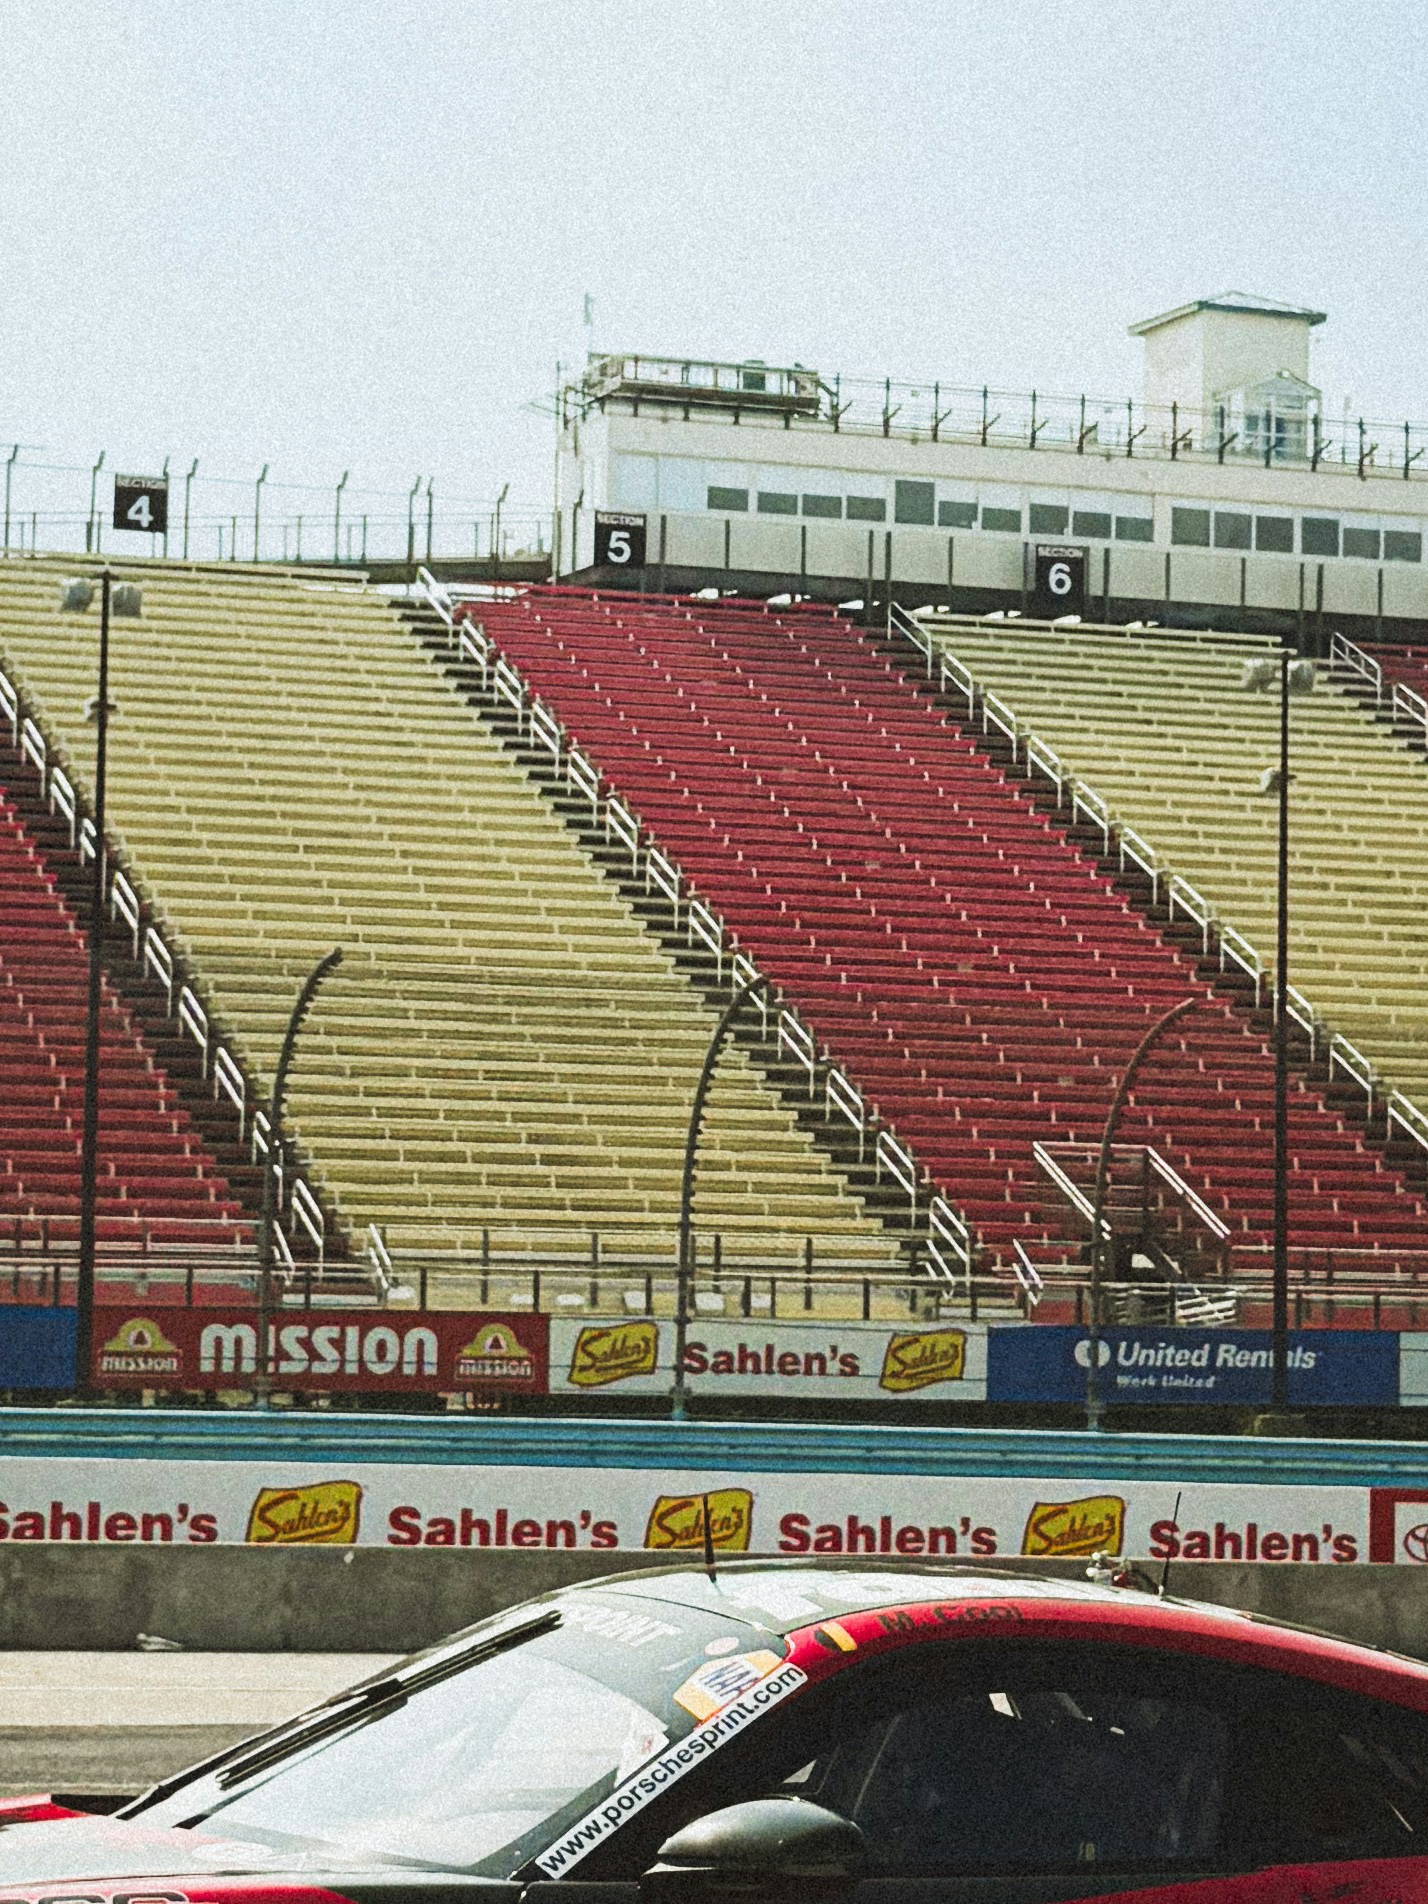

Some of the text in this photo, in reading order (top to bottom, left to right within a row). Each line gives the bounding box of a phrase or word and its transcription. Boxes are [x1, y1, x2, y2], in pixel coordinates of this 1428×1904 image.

[127, 495, 154, 528] 4
[607, 530, 632, 564] 5
[1048, 562, 1072, 595] 6
[683, 1341, 861, 1377] Sahlen's
[1117, 1341, 1210, 1368] United
[387, 1506, 619, 1549] Sahlen's
[778, 1513, 998, 1555] Sahlen's
[1149, 1520, 1359, 1563] Sahlen's
[541, 1664, 804, 1875] www.porschesprint.com
